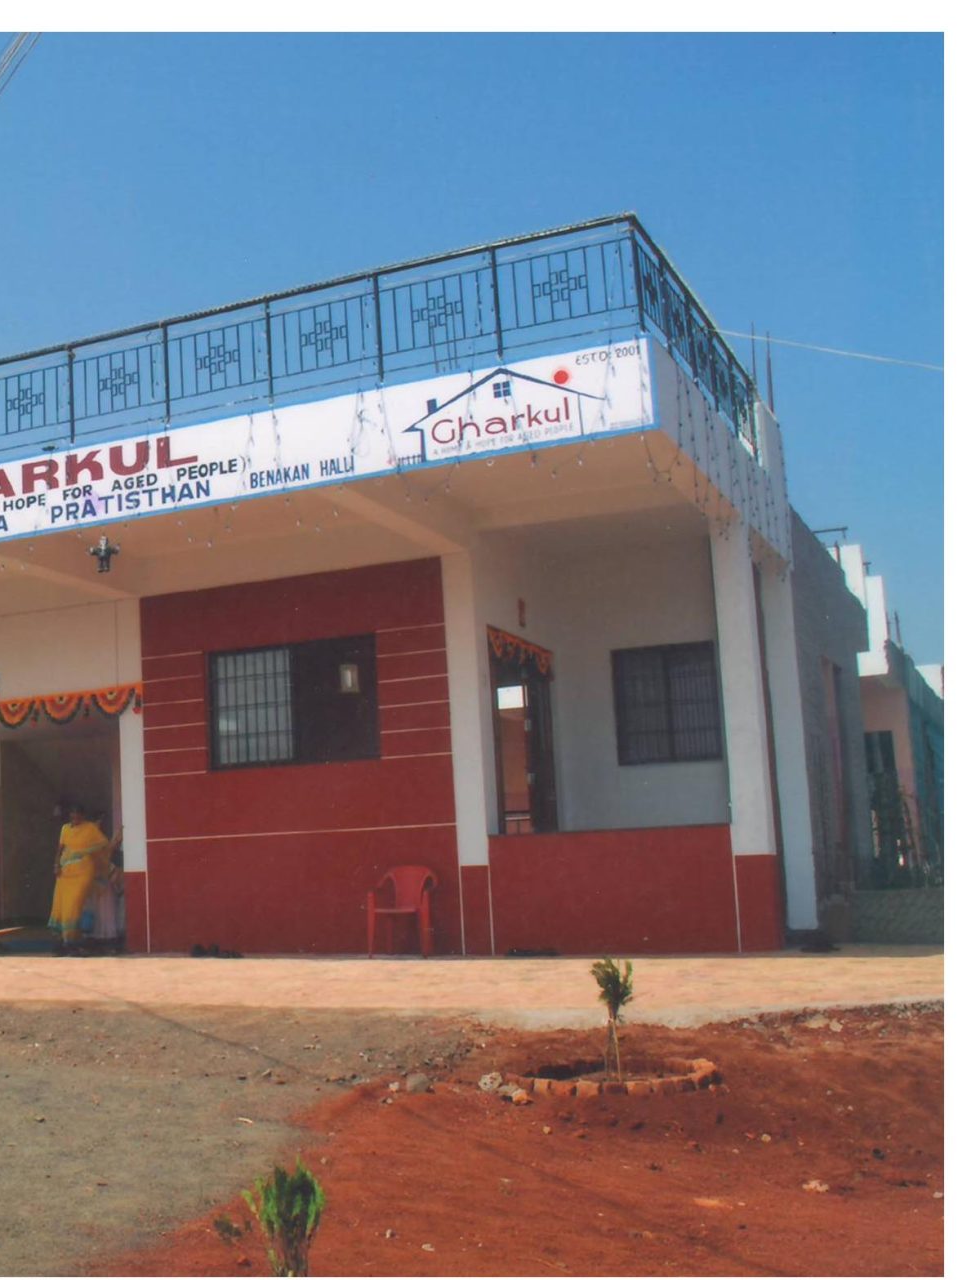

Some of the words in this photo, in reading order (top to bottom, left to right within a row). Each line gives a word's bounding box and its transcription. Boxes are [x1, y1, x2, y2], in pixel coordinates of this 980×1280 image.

[431, 396, 570, 444] Gharkul
[3, 494, 46, 512] HOPE
[63, 484, 93, 501] FOR
[112, 473, 158, 492] AGED
[177, 456, 246, 482] PEOPLE)
[51, 480, 211, 524] PRATISTHAN
[250, 463, 310, 489] BENAKAN
